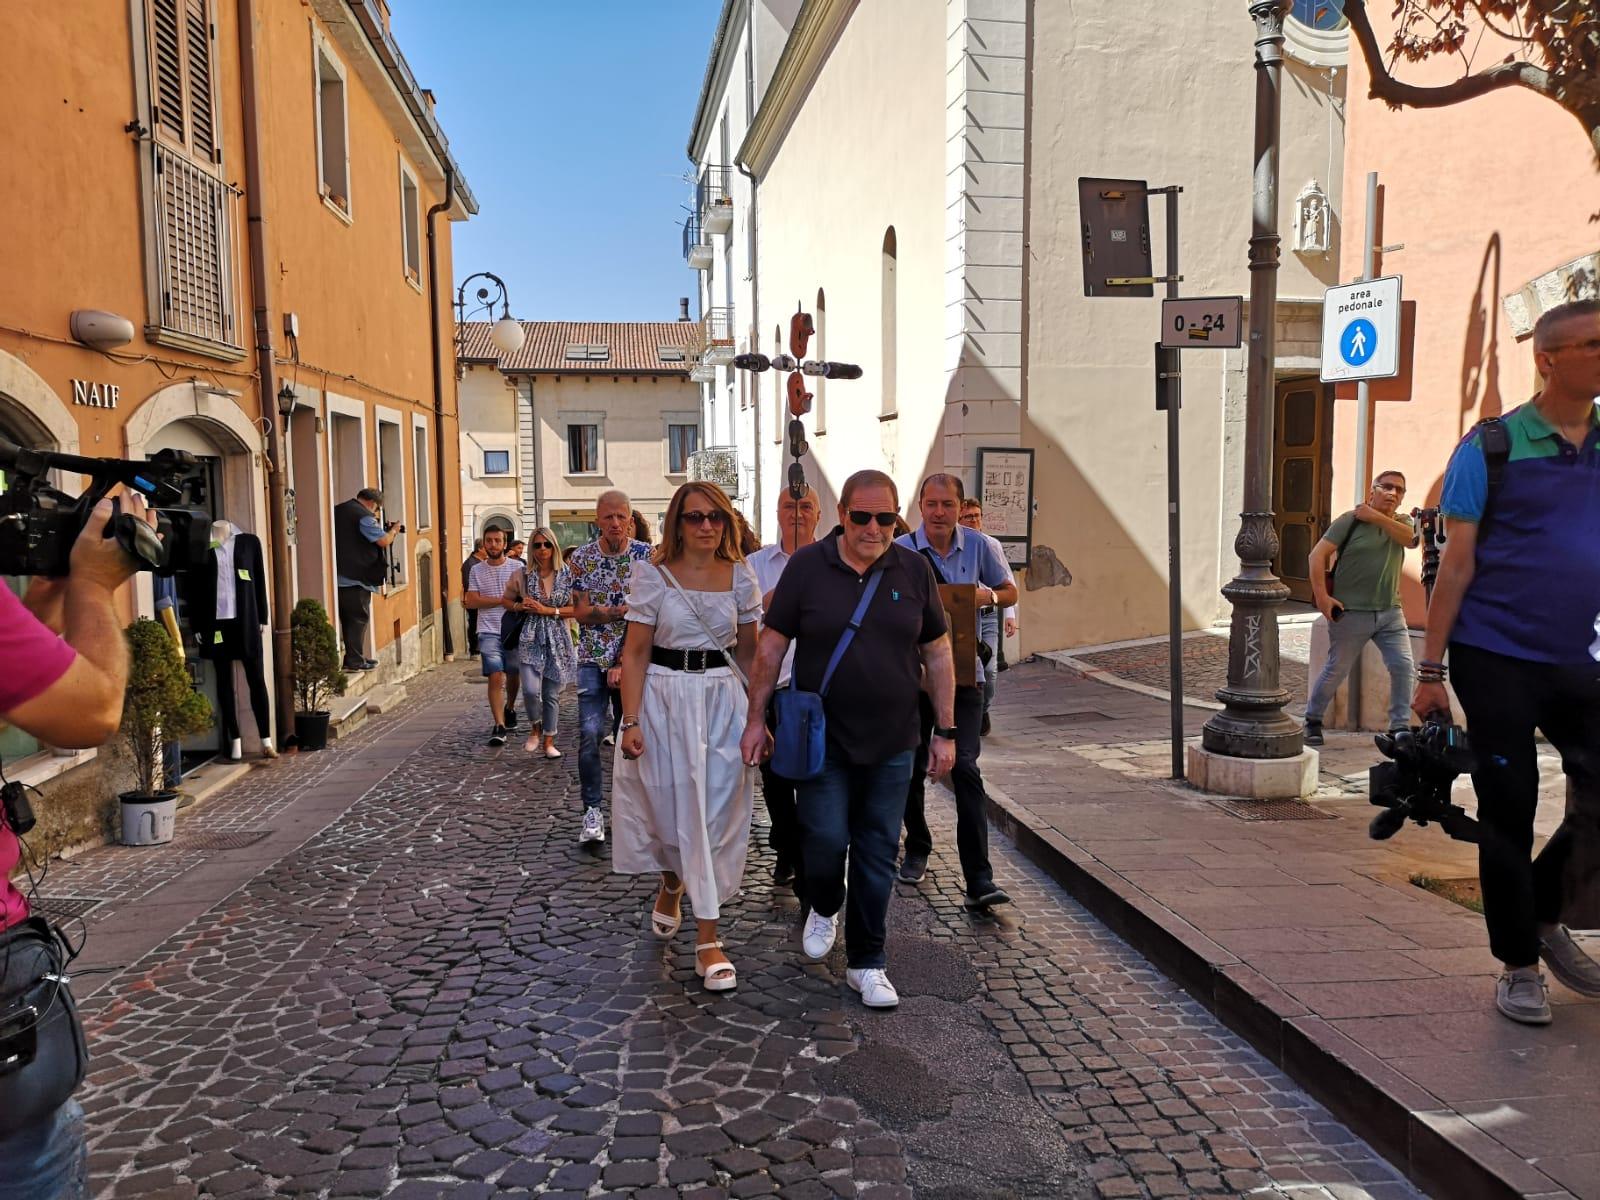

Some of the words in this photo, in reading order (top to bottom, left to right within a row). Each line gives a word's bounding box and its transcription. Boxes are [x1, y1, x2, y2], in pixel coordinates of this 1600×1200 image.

[1350, 289, 1371, 300] area
[1338, 298, 1383, 315] pedonale
[1174, 315, 1185, 332] 0
[1202, 314, 1225, 332] 24
[71, 378, 120, 409] NAIF
